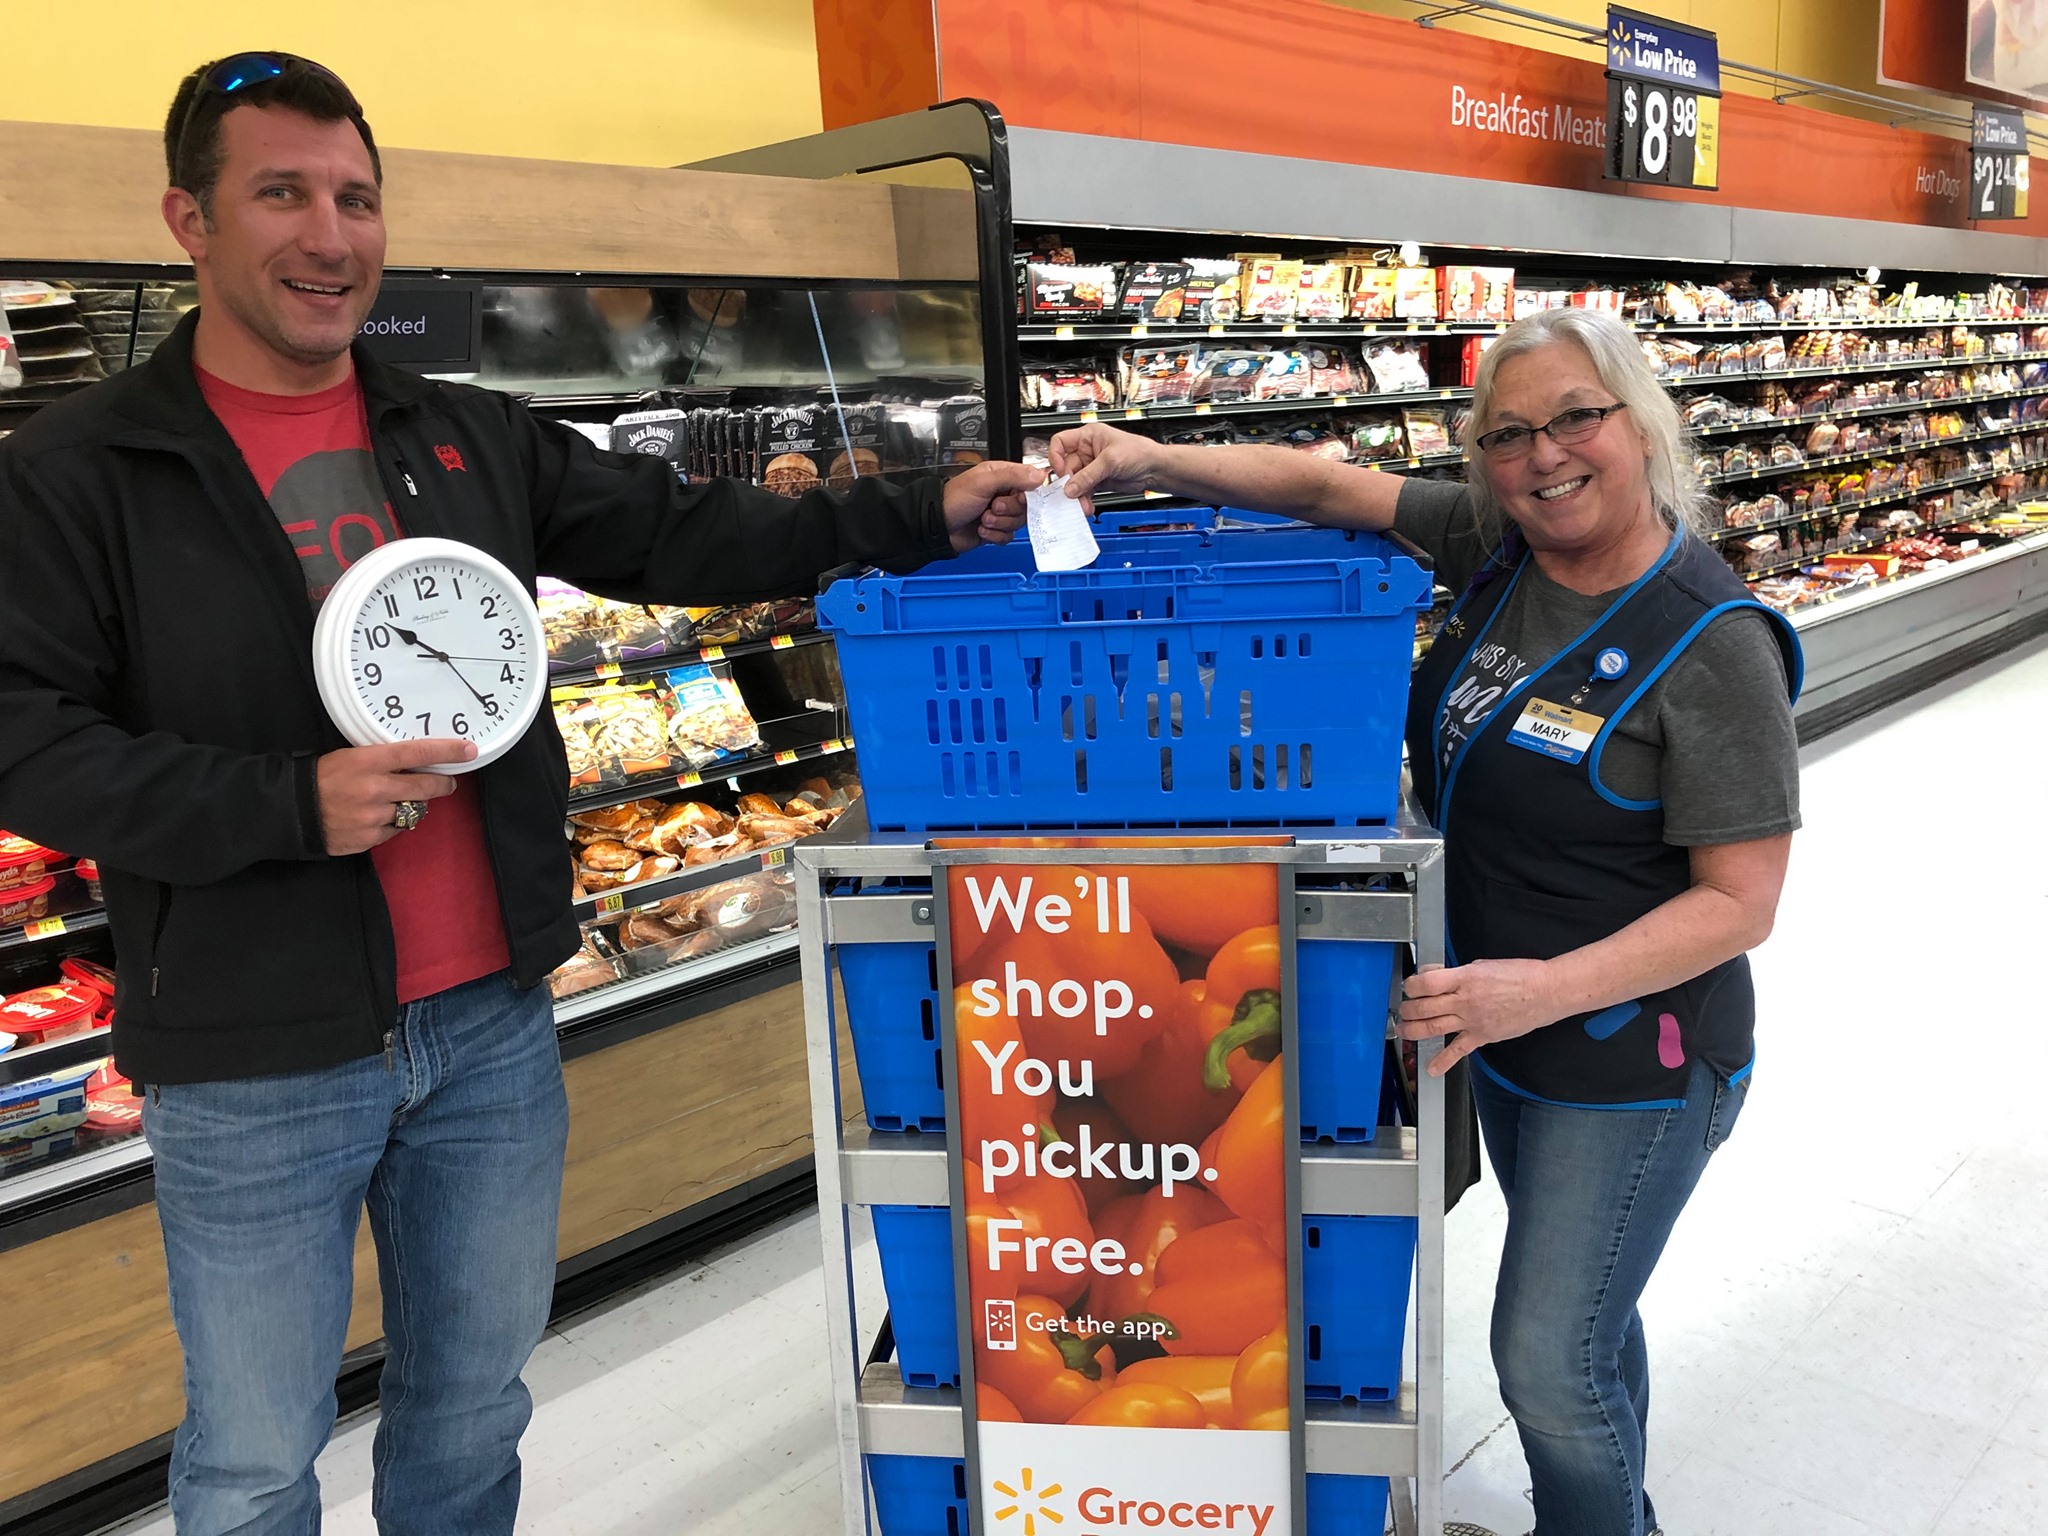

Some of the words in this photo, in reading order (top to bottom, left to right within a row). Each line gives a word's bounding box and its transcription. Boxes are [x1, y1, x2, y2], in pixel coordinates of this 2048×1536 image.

[1635, 42, 1663, 71] Low
[1664, 48, 1697, 79] Price
[1451, 85, 1549, 141] Breakfast
[1915, 166, 1936, 193] Hot
[1936, 169, 1960, 204] Dogs
[771, 409, 789, 429] JACK
[627, 428, 647, 447] JACK
[645, 424, 676, 443] DANIEL'S
[770, 443, 790, 452] PULLED
[790, 442, 813, 450] CHICKEN
[413, 575, 439, 601] 12
[452, 577, 463, 600] 1
[384, 594, 400, 618] 11
[480, 596, 498, 620] 2
[364, 625, 391, 651] 10
[498, 628, 516, 650] 3
[363, 662, 382, 686] 9
[499, 663, 515, 685] 4
[384, 695, 404, 719] 8
[480, 693, 499, 717] 5
[1532, 703, 1544, 712] 20
[415, 712, 432, 736] 7
[452, 712, 469, 735] 6
[1544, 710, 1574, 725] Walmart
[1529, 721, 1571, 742] MARY
[964, 876, 1131, 934] We'll
[971, 961, 1154, 1036] shop.
[971, 1040, 1094, 1097] You
[980, 1123, 1219, 1198] pickup.
[986, 1219, 1144, 1276] Free.
[1025, 1312, 1070, 1333] Get
[1074, 1314, 1116, 1335] the
[1122, 1321, 1174, 1341] app.
[1077, 1486, 1275, 1536] Grocery
